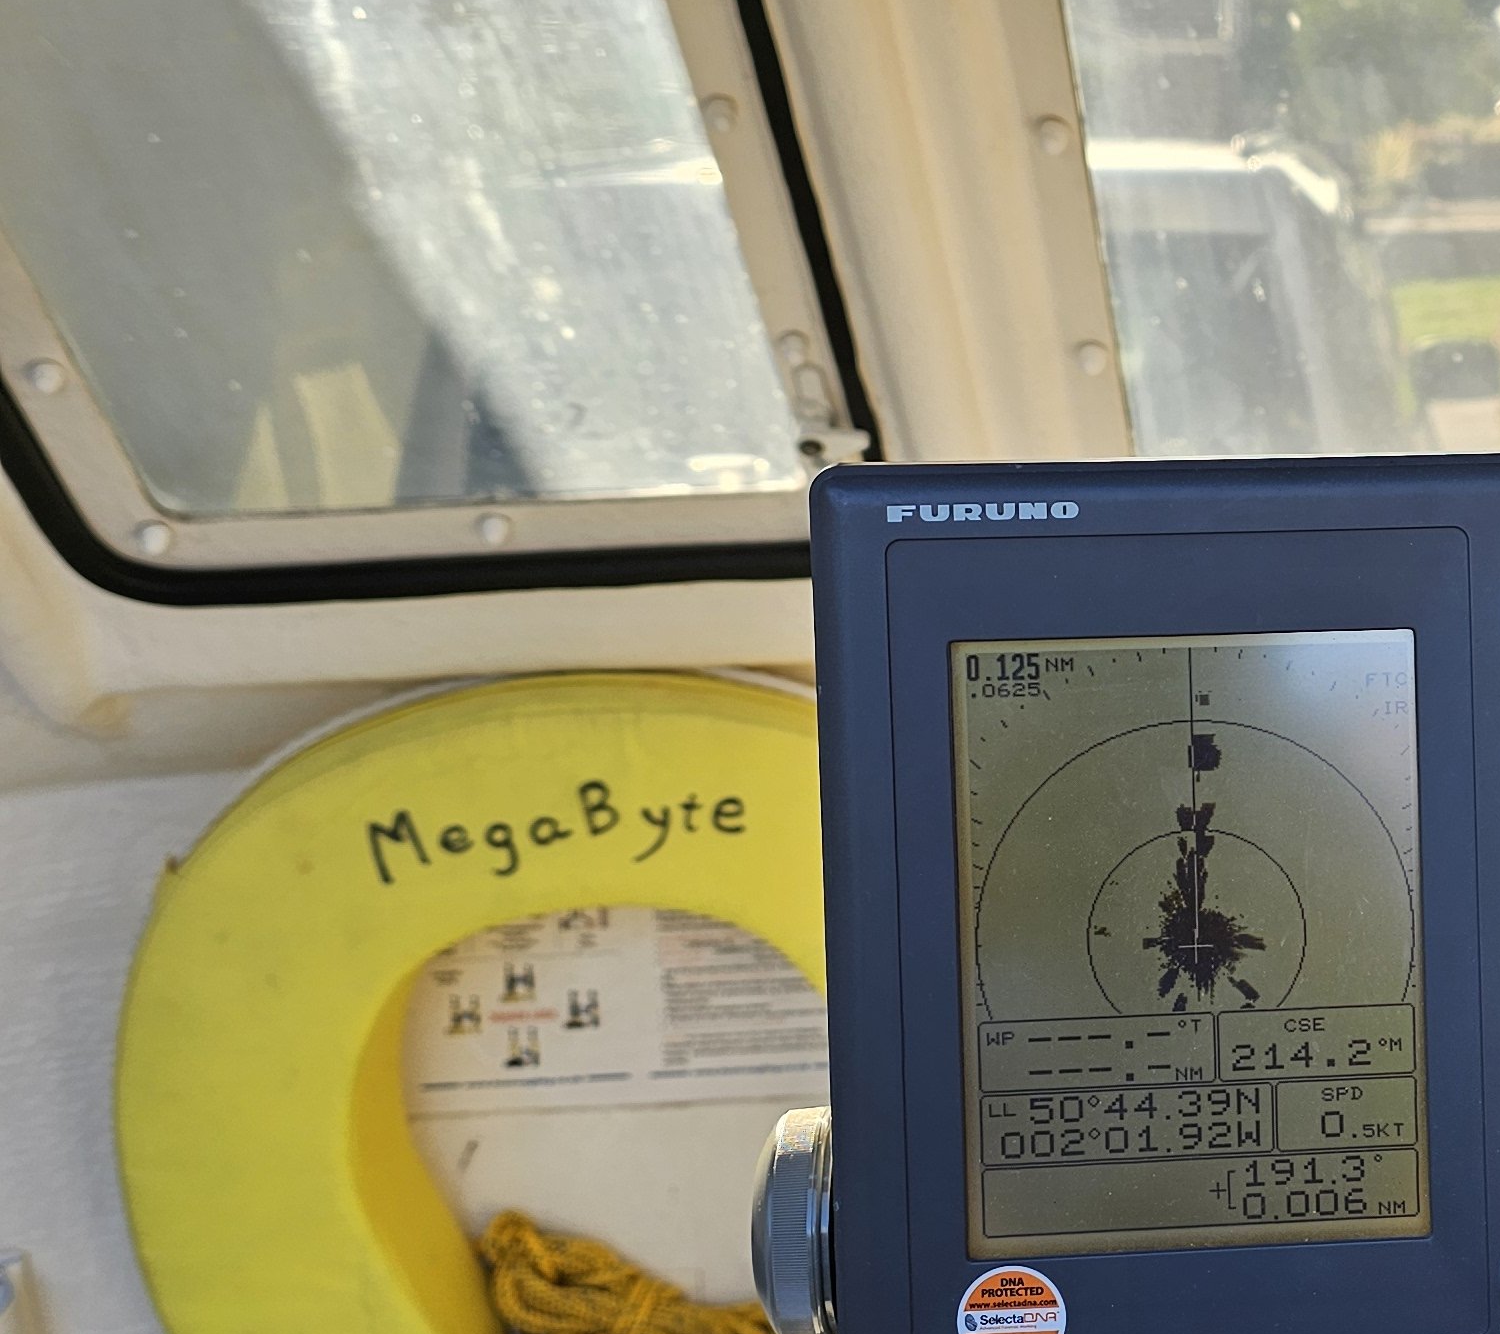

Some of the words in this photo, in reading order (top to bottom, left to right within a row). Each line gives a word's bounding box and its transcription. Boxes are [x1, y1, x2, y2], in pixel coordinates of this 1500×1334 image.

[886, 501, 1080, 523] FURUNO
[967, 653, 1040, 681] 0.125
[1046, 657, 1073, 672] NM
[1284, 1017, 1325, 1033] CSE
[986, 1031, 1014, 1047] WP
[1232, 1039, 1371, 1072] 214.2
[1175, 1066, 1203, 1082] NM
[1322, 1086, 1363, 1101] SPD
[989, 1102, 1016, 1118] LL
[1242, 1188, 1367, 1220] 0.006
[1378, 1200, 1406, 1215] NM
[1001, 1278, 1024, 1287] DNA
[982, 1287, 1044, 1298] PROTECTED
[969, 1299, 1056, 1308] www.selectadna.com
